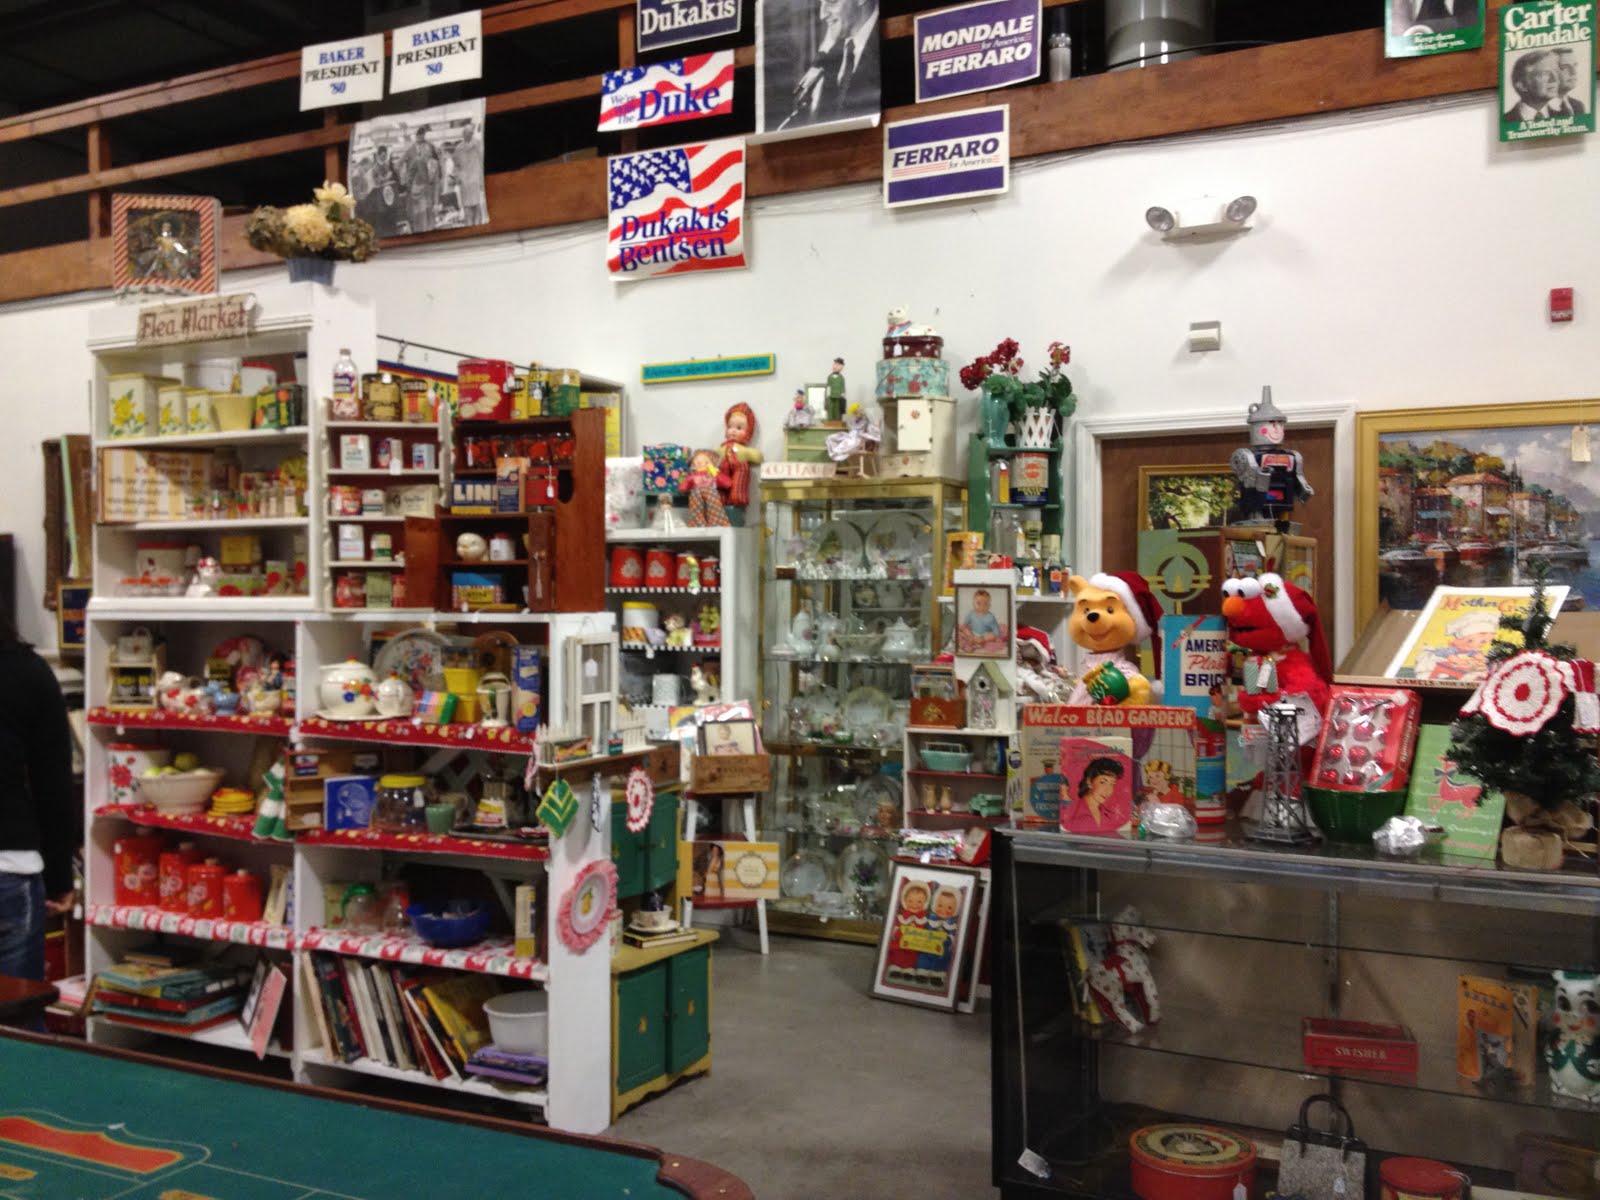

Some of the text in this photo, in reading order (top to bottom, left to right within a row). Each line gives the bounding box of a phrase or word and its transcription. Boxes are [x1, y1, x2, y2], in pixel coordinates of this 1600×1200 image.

[641, 0, 736, 35] Dukakis
[1504, 3, 1592, 32] Carter
[412, 24, 461, 47] BAKER
[921, 14, 1035, 53] MONDALE
[981, 35, 1025, 50] for America
[1504, 23, 1592, 51] Mondale
[319, 47, 365, 65] BAKER
[396, 37, 478, 66] PRESIDENT
[925, 42, 1032, 79] FERRARO
[305, 60, 380, 83] PRESIDENT
[638, 83, 720, 121] Duke
[892, 137, 999, 169] FERRARO
[948, 156, 994, 170] for America
[620, 204, 729, 242] Dukakis
[619, 237, 728, 272] Bentsen
[140, 301, 246, 339] Flea Market
[1028, 706, 1194, 726] Walco BEAD GARDENS
[1335, 1047, 1387, 1060] SWISHER
